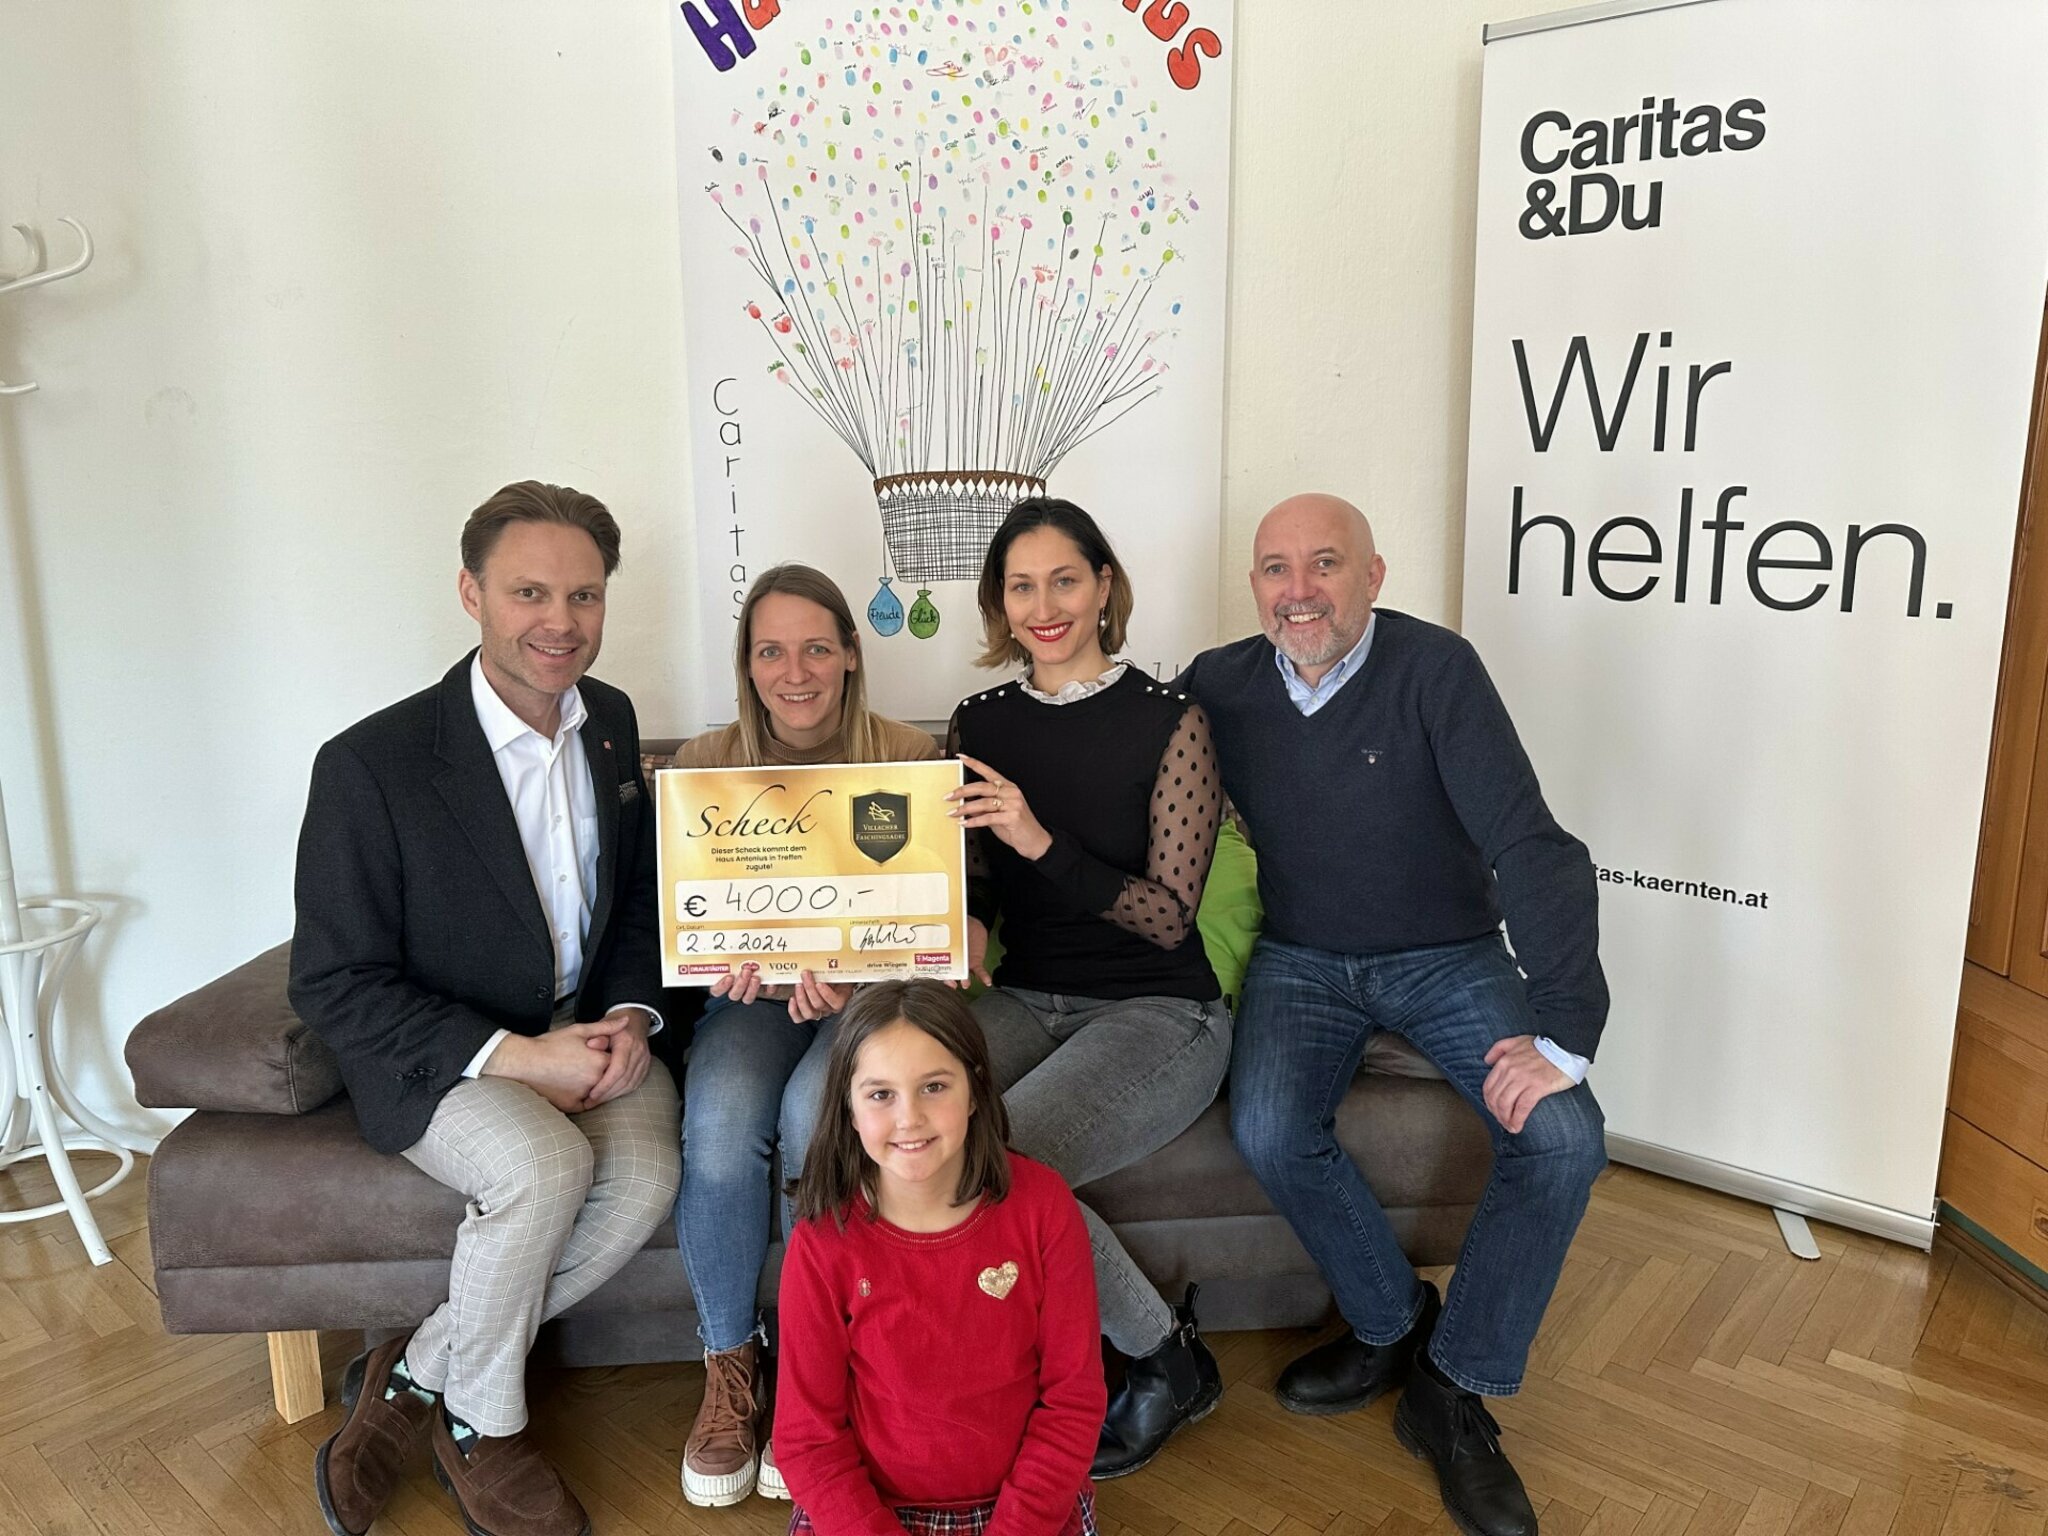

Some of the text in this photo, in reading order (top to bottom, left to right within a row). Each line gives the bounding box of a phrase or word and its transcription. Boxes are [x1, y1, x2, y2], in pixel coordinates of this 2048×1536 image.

[1520, 96, 1766, 174] Caritas
[1518, 172, 1663, 240] &Du
[1512, 331, 1732, 453] Wir
[1508, 486, 1954, 620] helfen.
[871, 606, 901, 620] Freude
[911, 608, 937, 624] Glück
[686, 784, 833, 838] Scheck
[711, 847, 734, 855] Dieser
[735, 846, 761, 854] Scheck
[762, 845, 788, 853] kommt
[735, 854, 768, 862] Antonius
[745, 863, 773, 872] zugute!
[684, 895, 707, 918] €
